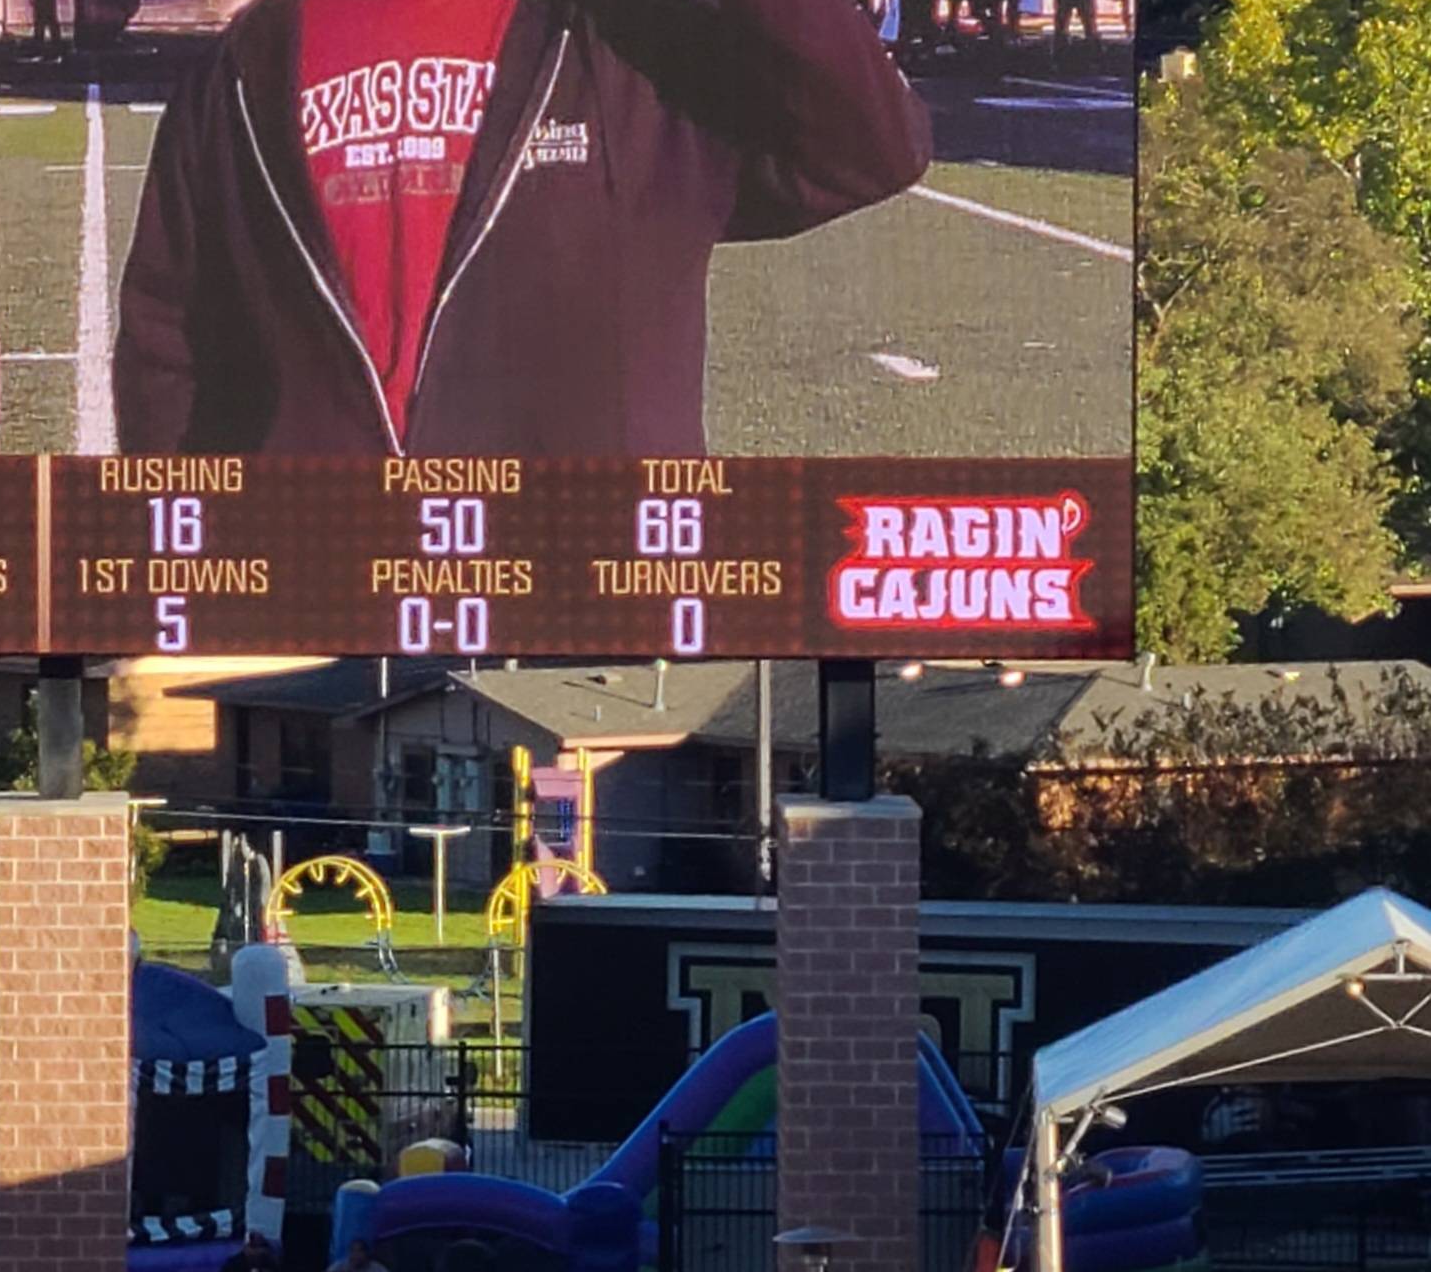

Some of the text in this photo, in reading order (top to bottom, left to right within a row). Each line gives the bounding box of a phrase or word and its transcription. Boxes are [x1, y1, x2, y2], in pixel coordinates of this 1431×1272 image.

[101, 458, 243, 492] RUSHING
[384, 458, 521, 492] PASSING
[642, 459, 733, 494] TOTAL
[148, 497, 203, 553] 16
[420, 498, 484, 553] 50
[637, 499, 702, 554] 66
[79, 559, 268, 594] 1ST DOWNS
[372, 559, 533, 595] PENALTIES
[592, 560, 782, 596] TURNOVERS
[838, 568, 1073, 620] CAJUNS
[156, 597, 187, 652] 5
[399, 597, 489, 653] 0-0
[672, 598, 704, 654] 0
